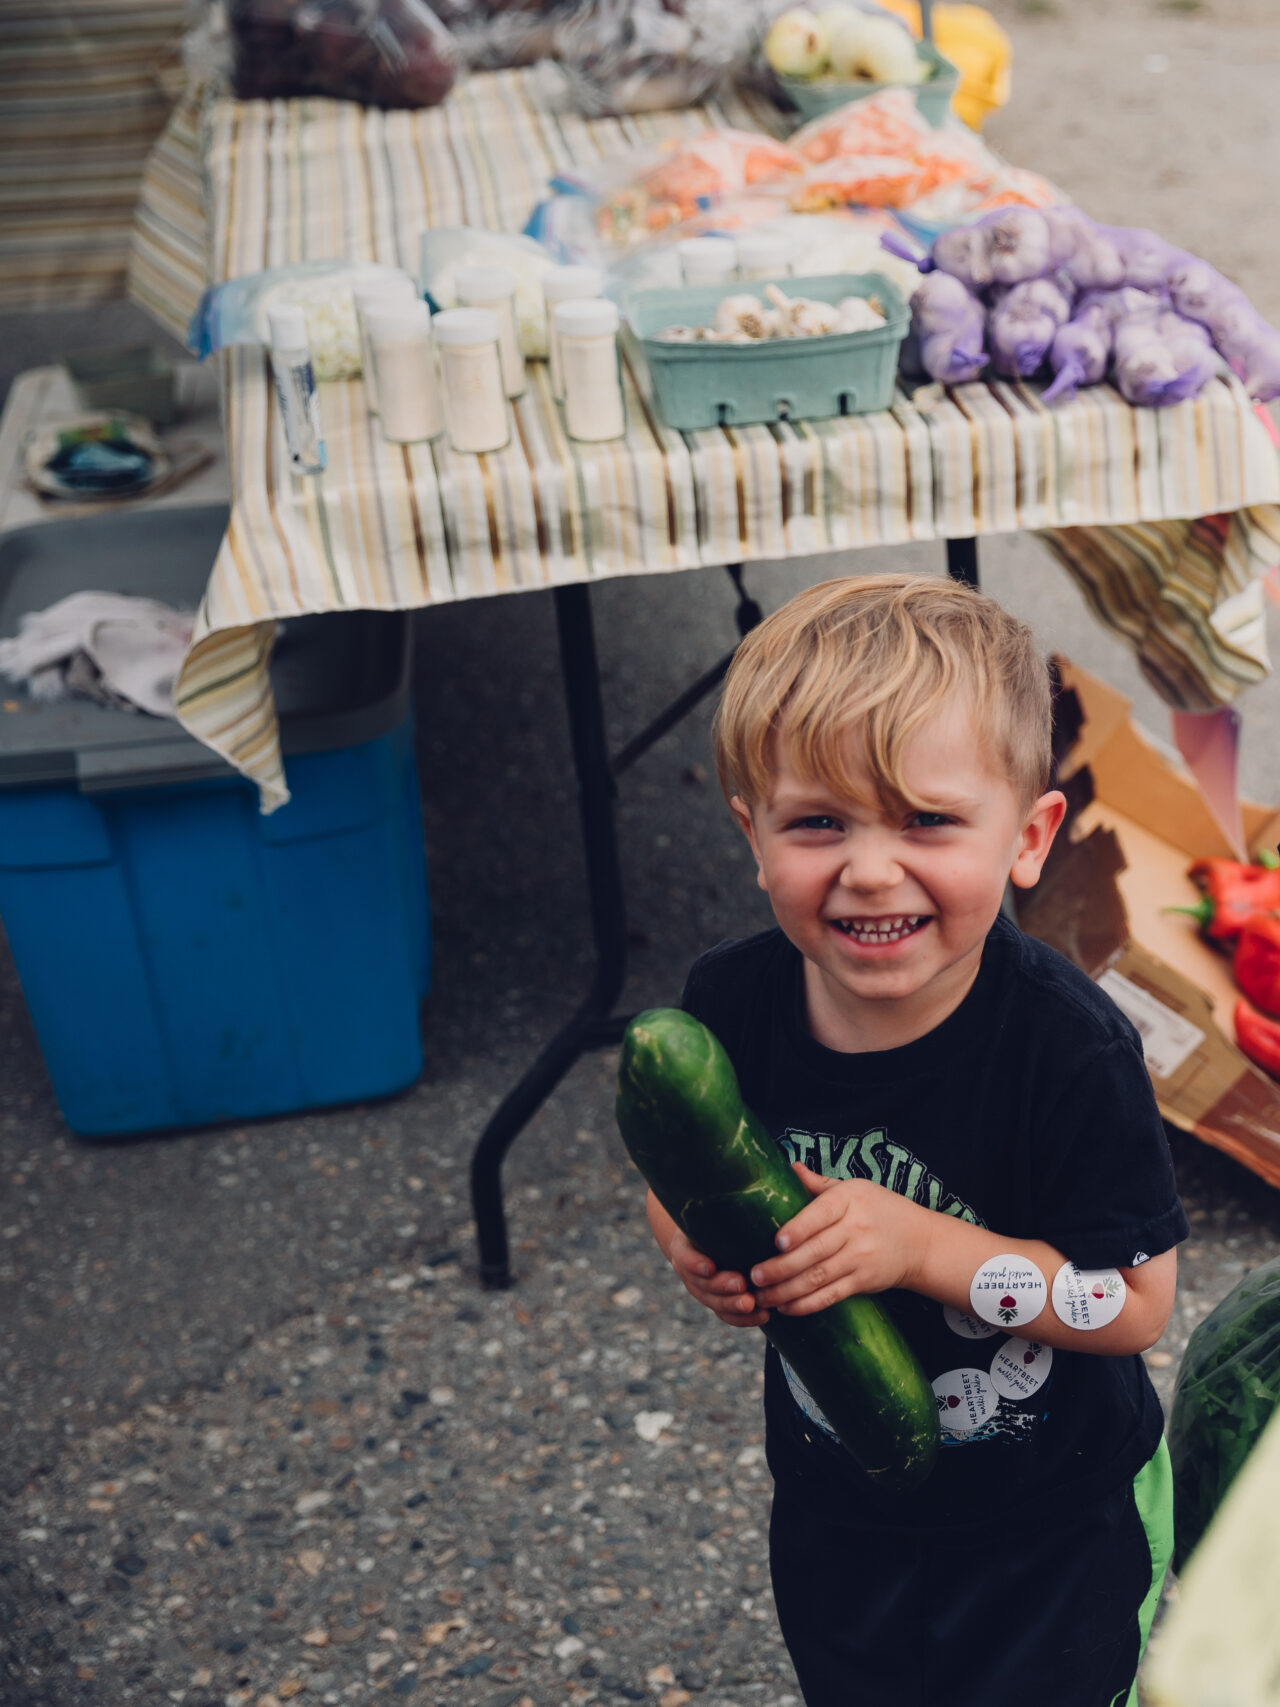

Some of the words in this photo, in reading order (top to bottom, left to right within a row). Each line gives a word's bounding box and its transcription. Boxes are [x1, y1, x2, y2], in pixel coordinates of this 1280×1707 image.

[981, 1266, 1007, 1282] garden
[1008, 1270, 1033, 1282] market
[976, 1281, 1042, 1290] HEARTBEET
[1071, 1262, 1090, 1325] HEARTBEET
[1064, 1300, 1081, 1324] garden
[997, 1367, 1018, 1383] market
[1009, 1379, 1029, 1394] garden
[998, 1353, 1039, 1387] HEARTBEET
[970, 1373, 987, 1394] garden
[961, 1373, 978, 1425] HEARTBEET
[969, 1395, 986, 1415] market
